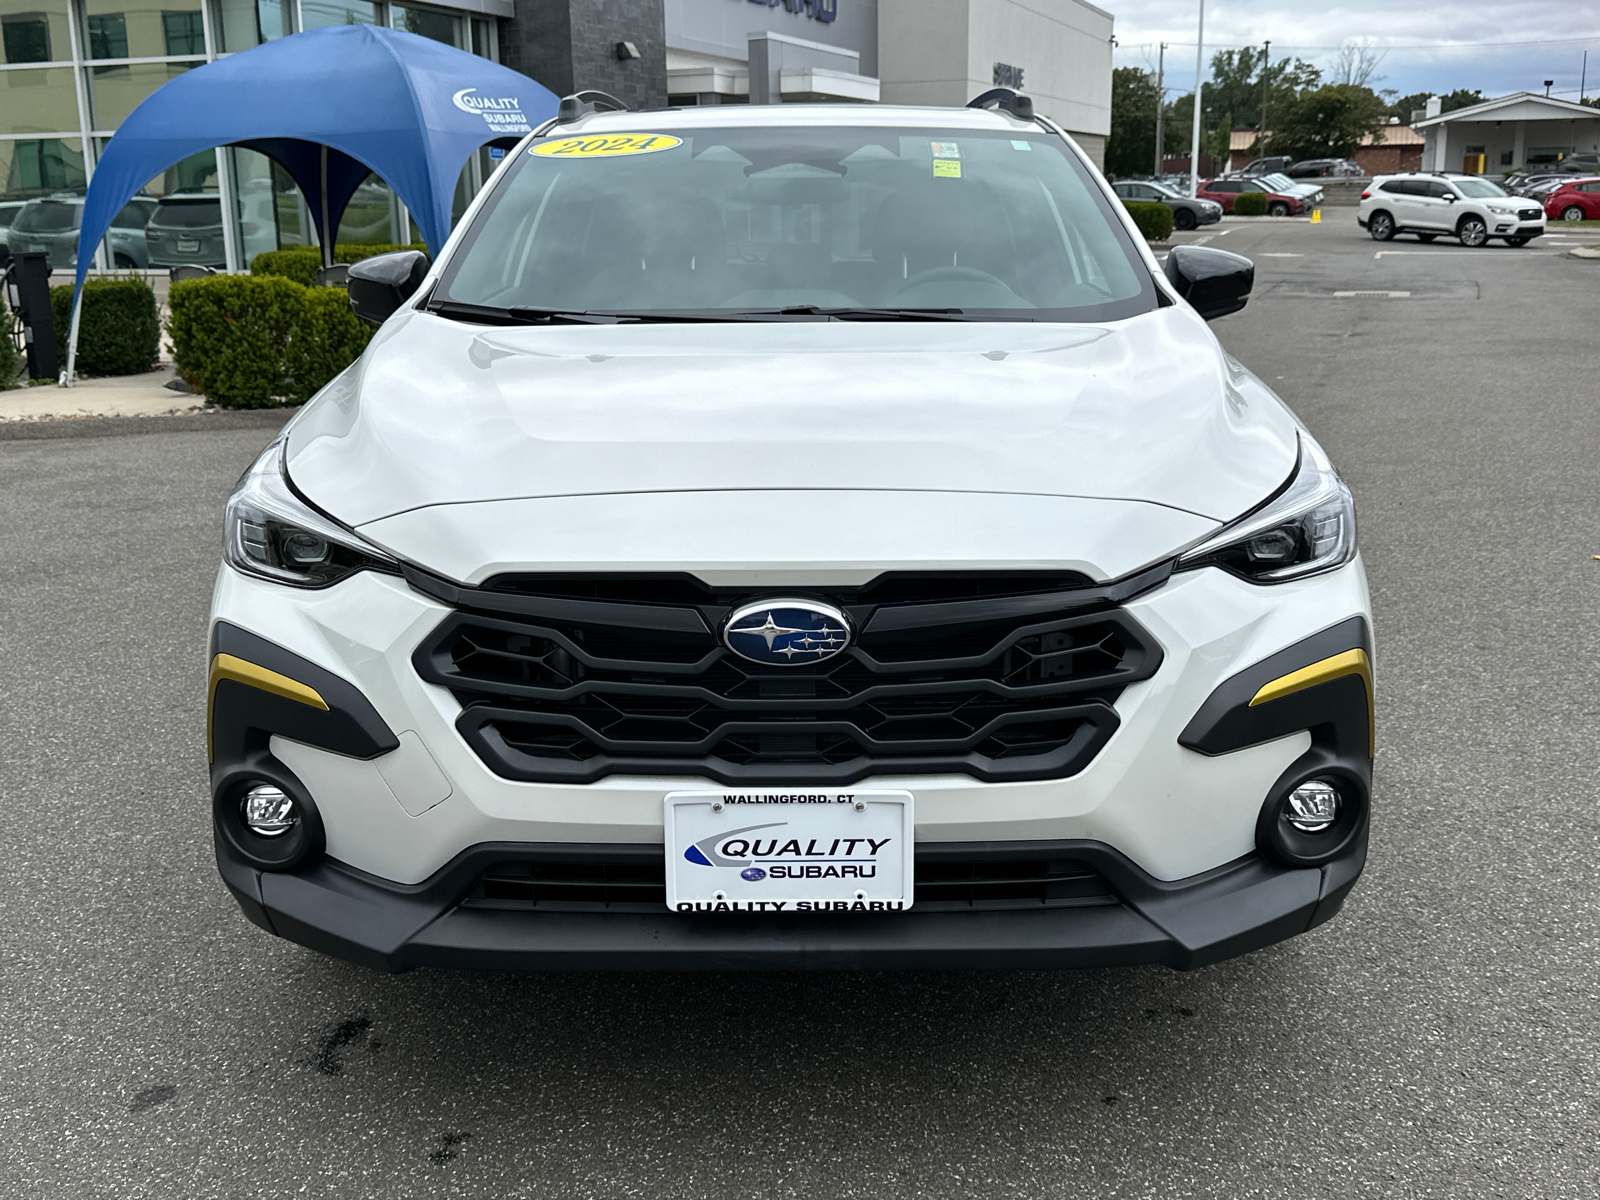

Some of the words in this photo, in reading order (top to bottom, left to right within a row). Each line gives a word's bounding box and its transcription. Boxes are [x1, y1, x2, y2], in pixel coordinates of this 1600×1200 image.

[463, 96, 519, 109] QUALITY
[482, 113, 527, 123] SUBARU
[552, 136, 659, 155] 2024
[723, 794, 831, 804] WALLINGFORD,
[837, 794, 855, 804] CT
[721, 838, 891, 858] QUALITY
[769, 865, 876, 878] SUBARU
[676, 901, 788, 912] QUALITY
[796, 901, 903, 912] SUBARU
